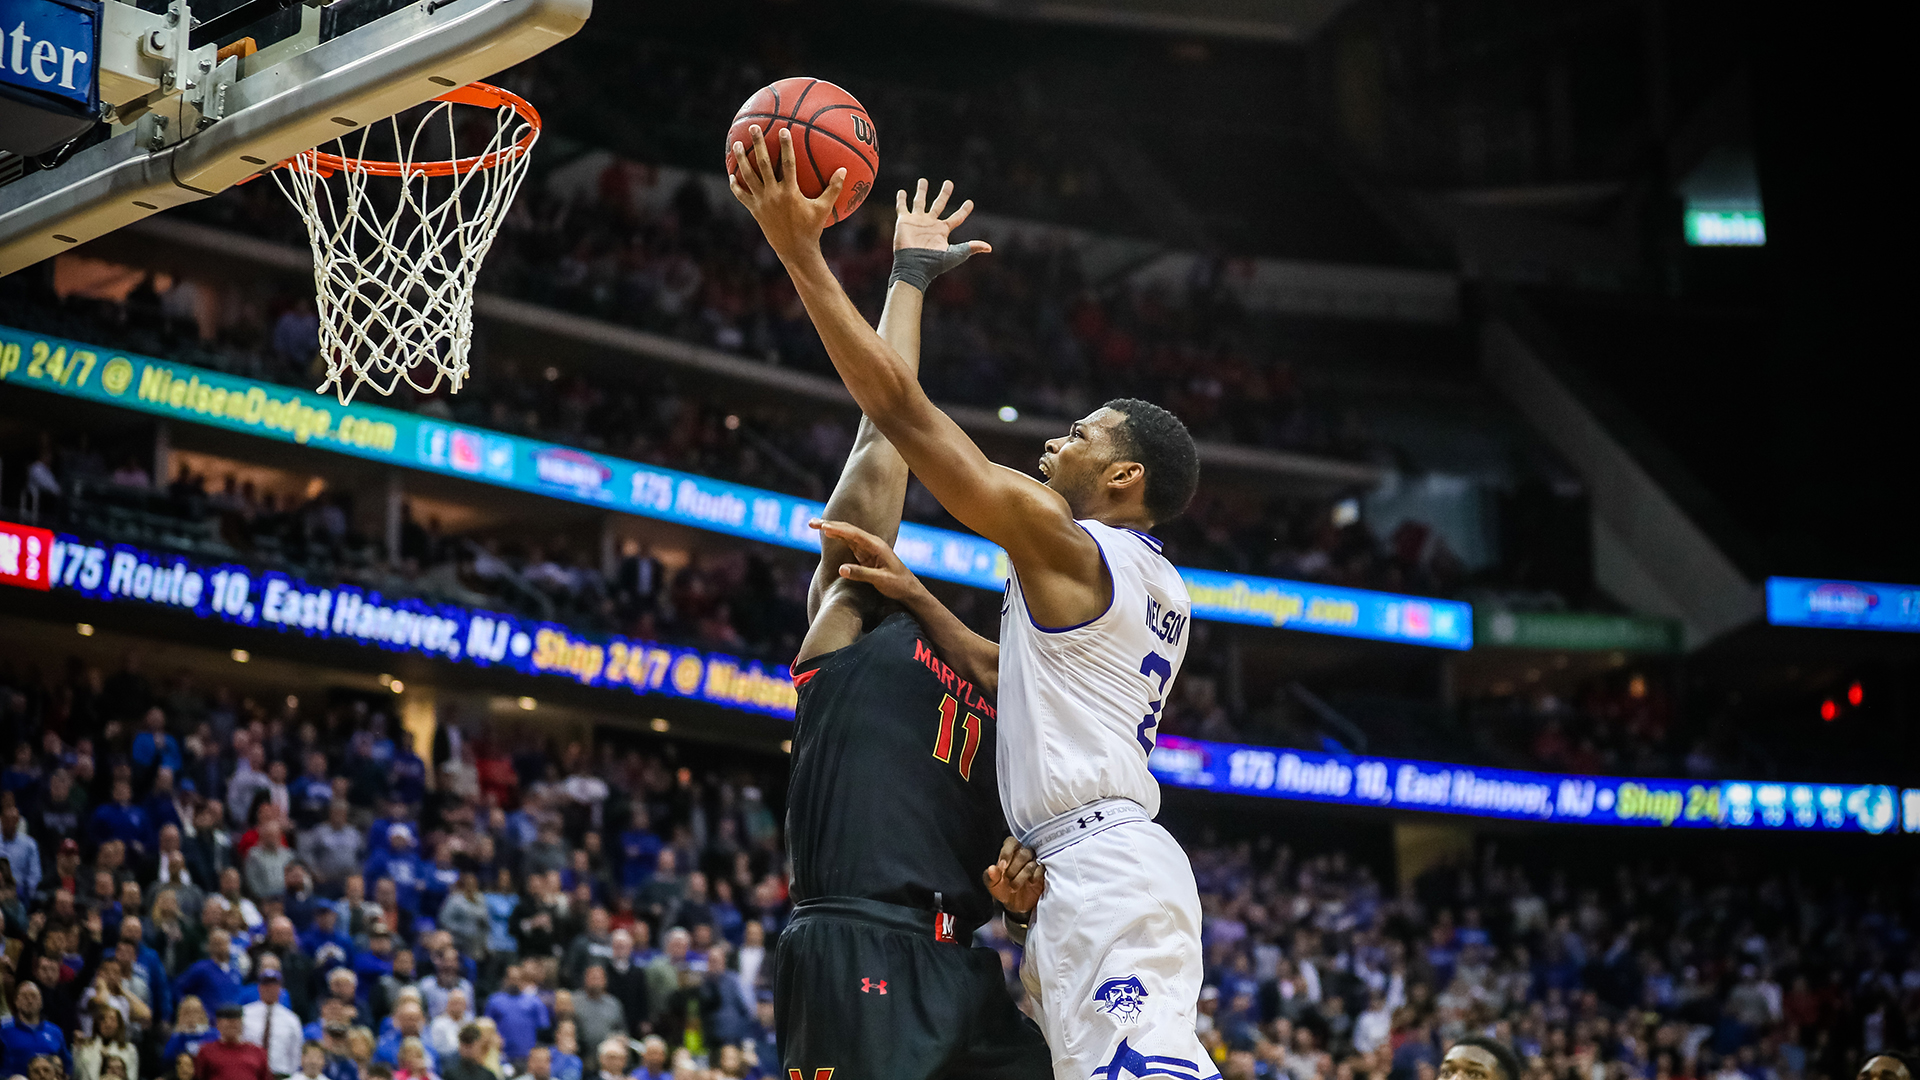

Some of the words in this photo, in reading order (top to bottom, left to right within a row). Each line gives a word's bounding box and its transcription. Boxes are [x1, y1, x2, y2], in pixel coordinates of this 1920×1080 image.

[0, 340, 21, 380] p
[27, 341, 97, 387] 24/7
[138, 365, 397, 452] NielsenDodge.com
[52, 540, 106, 590] 175
[109, 551, 203, 608] Route
[211, 569, 255, 623] 10,
[262, 579, 332, 631] East
[332, 590, 461, 661] Hanover,
[466, 615, 511, 662] NJ
[532, 628, 604, 684] Shop
[605, 642, 672, 689] 24/7
[1145, 594, 1187, 647] NELSON
[932, 693, 981, 782] 11
[1136, 650, 1172, 758] 2
[942, 912, 955, 936] M
